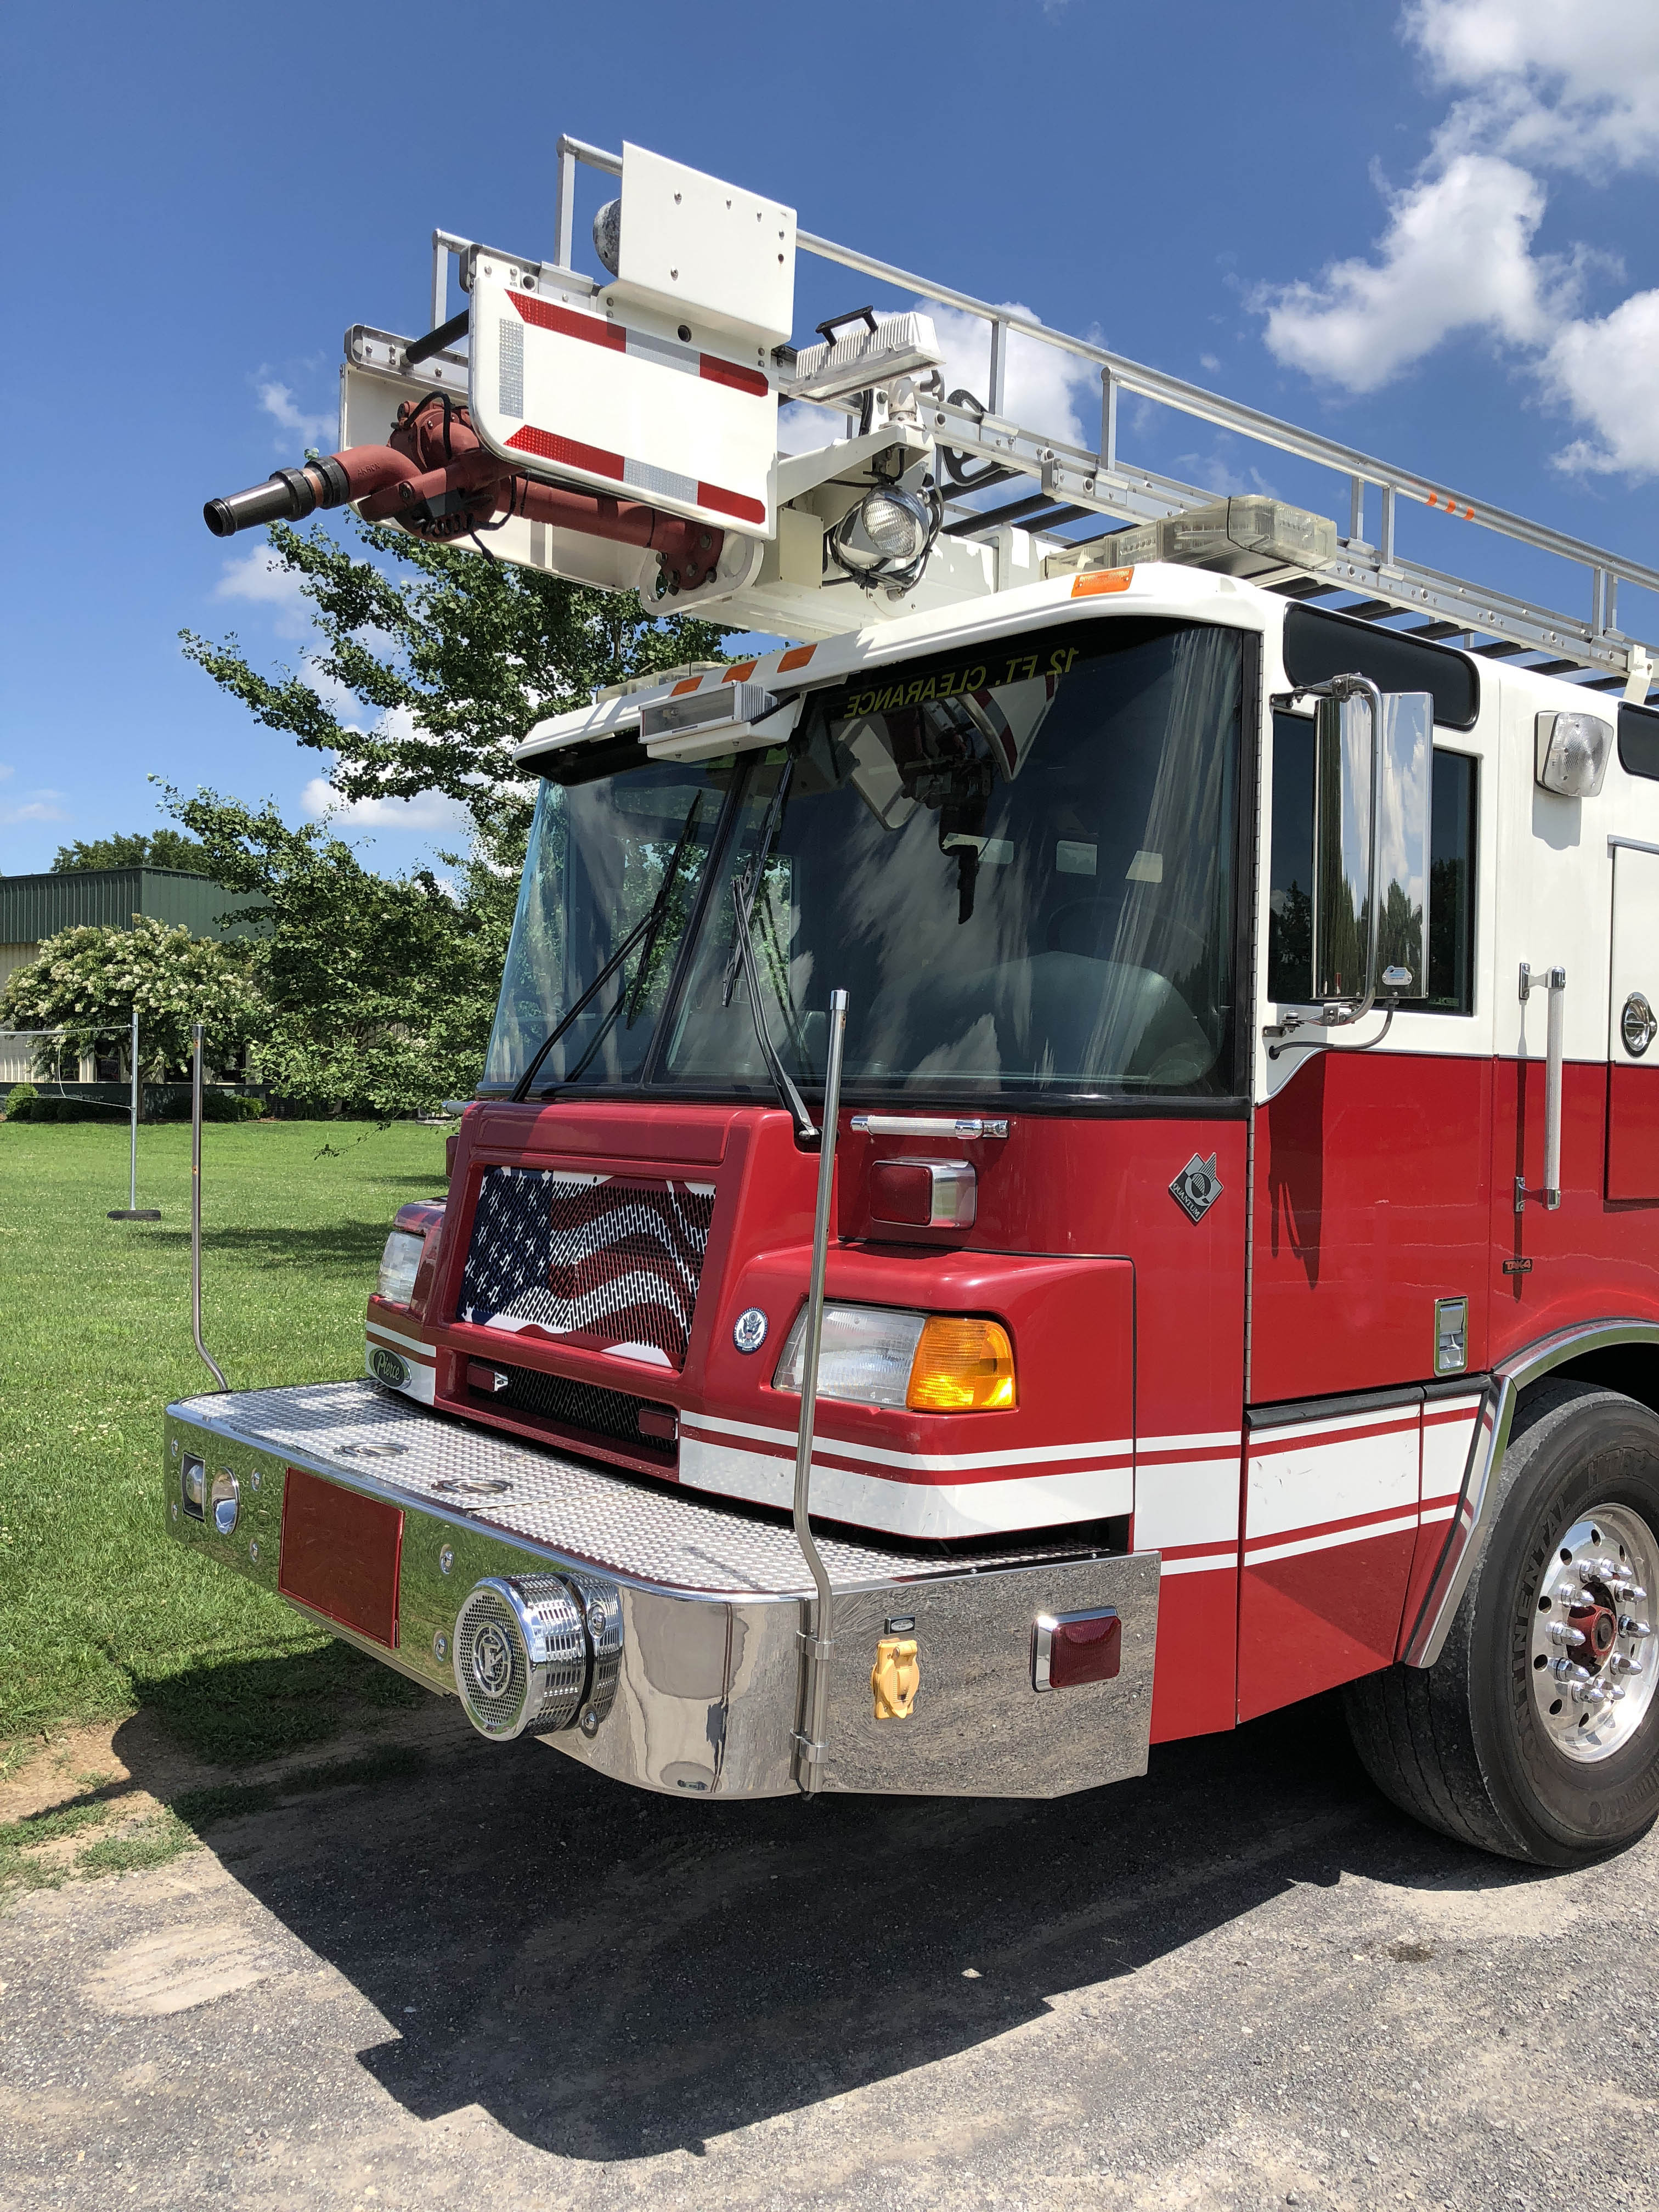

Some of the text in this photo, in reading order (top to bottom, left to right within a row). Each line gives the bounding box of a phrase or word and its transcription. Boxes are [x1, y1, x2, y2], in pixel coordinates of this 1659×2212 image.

[357, 462, 381, 476] AKRON
[1172, 1182, 1201, 1218] QUANTUM
[377, 1351, 400, 1381] Pierce
